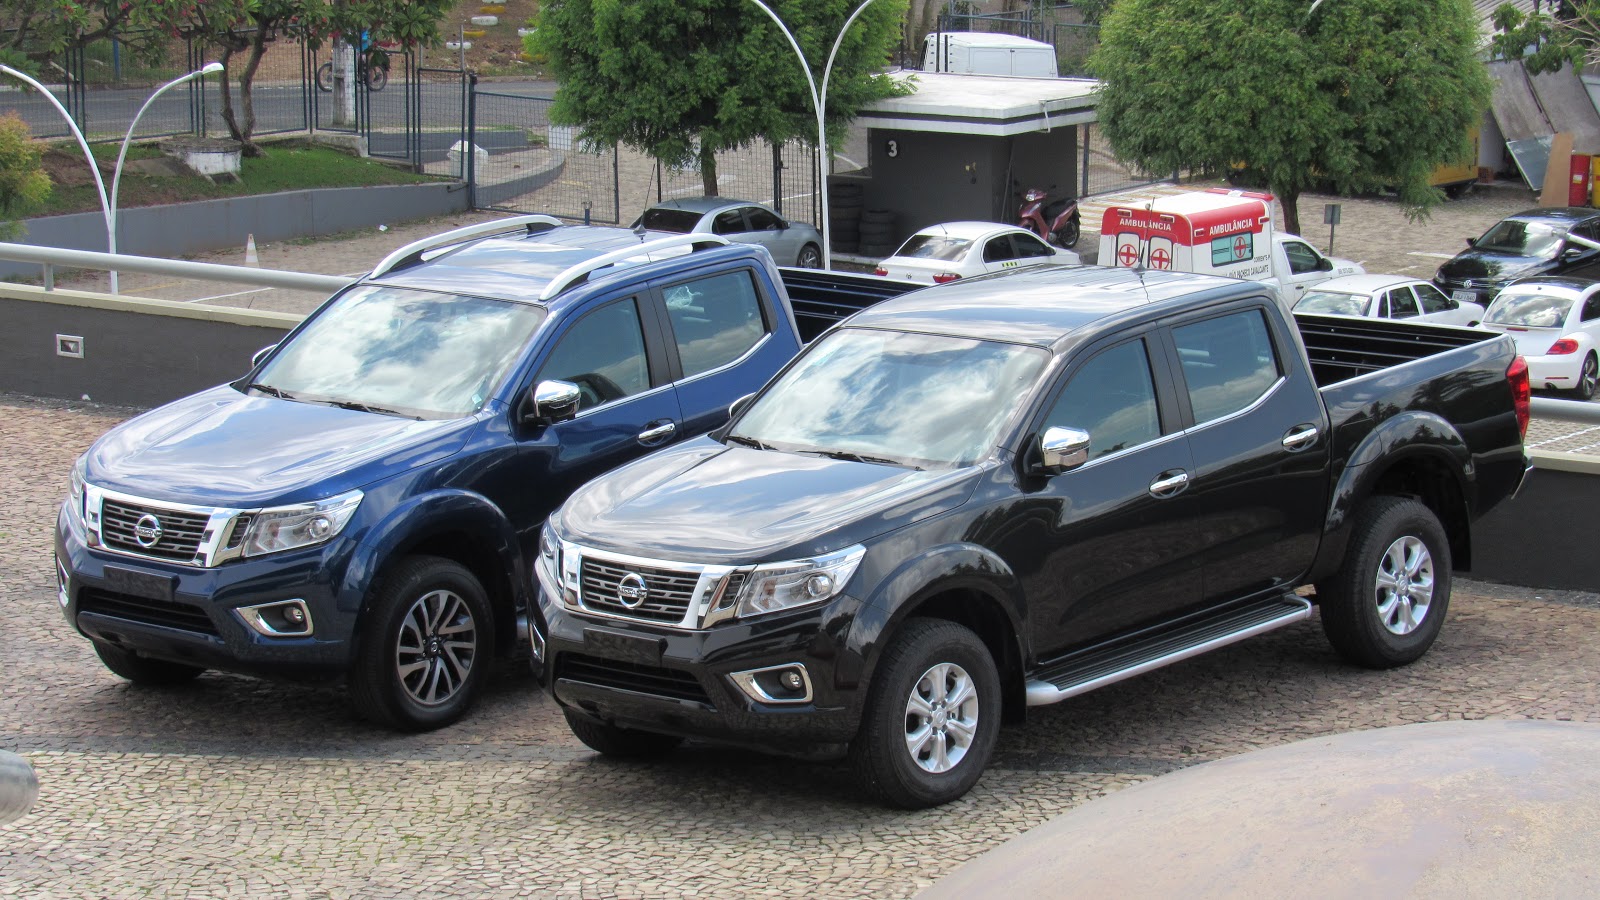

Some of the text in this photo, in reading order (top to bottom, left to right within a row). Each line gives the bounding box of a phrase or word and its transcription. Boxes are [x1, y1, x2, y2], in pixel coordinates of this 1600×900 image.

[888, 140, 897, 157] 3
[1119, 218, 1171, 231] AMBULÂNCIA
[1209, 218, 1253, 236] AMBULÂNCIA
